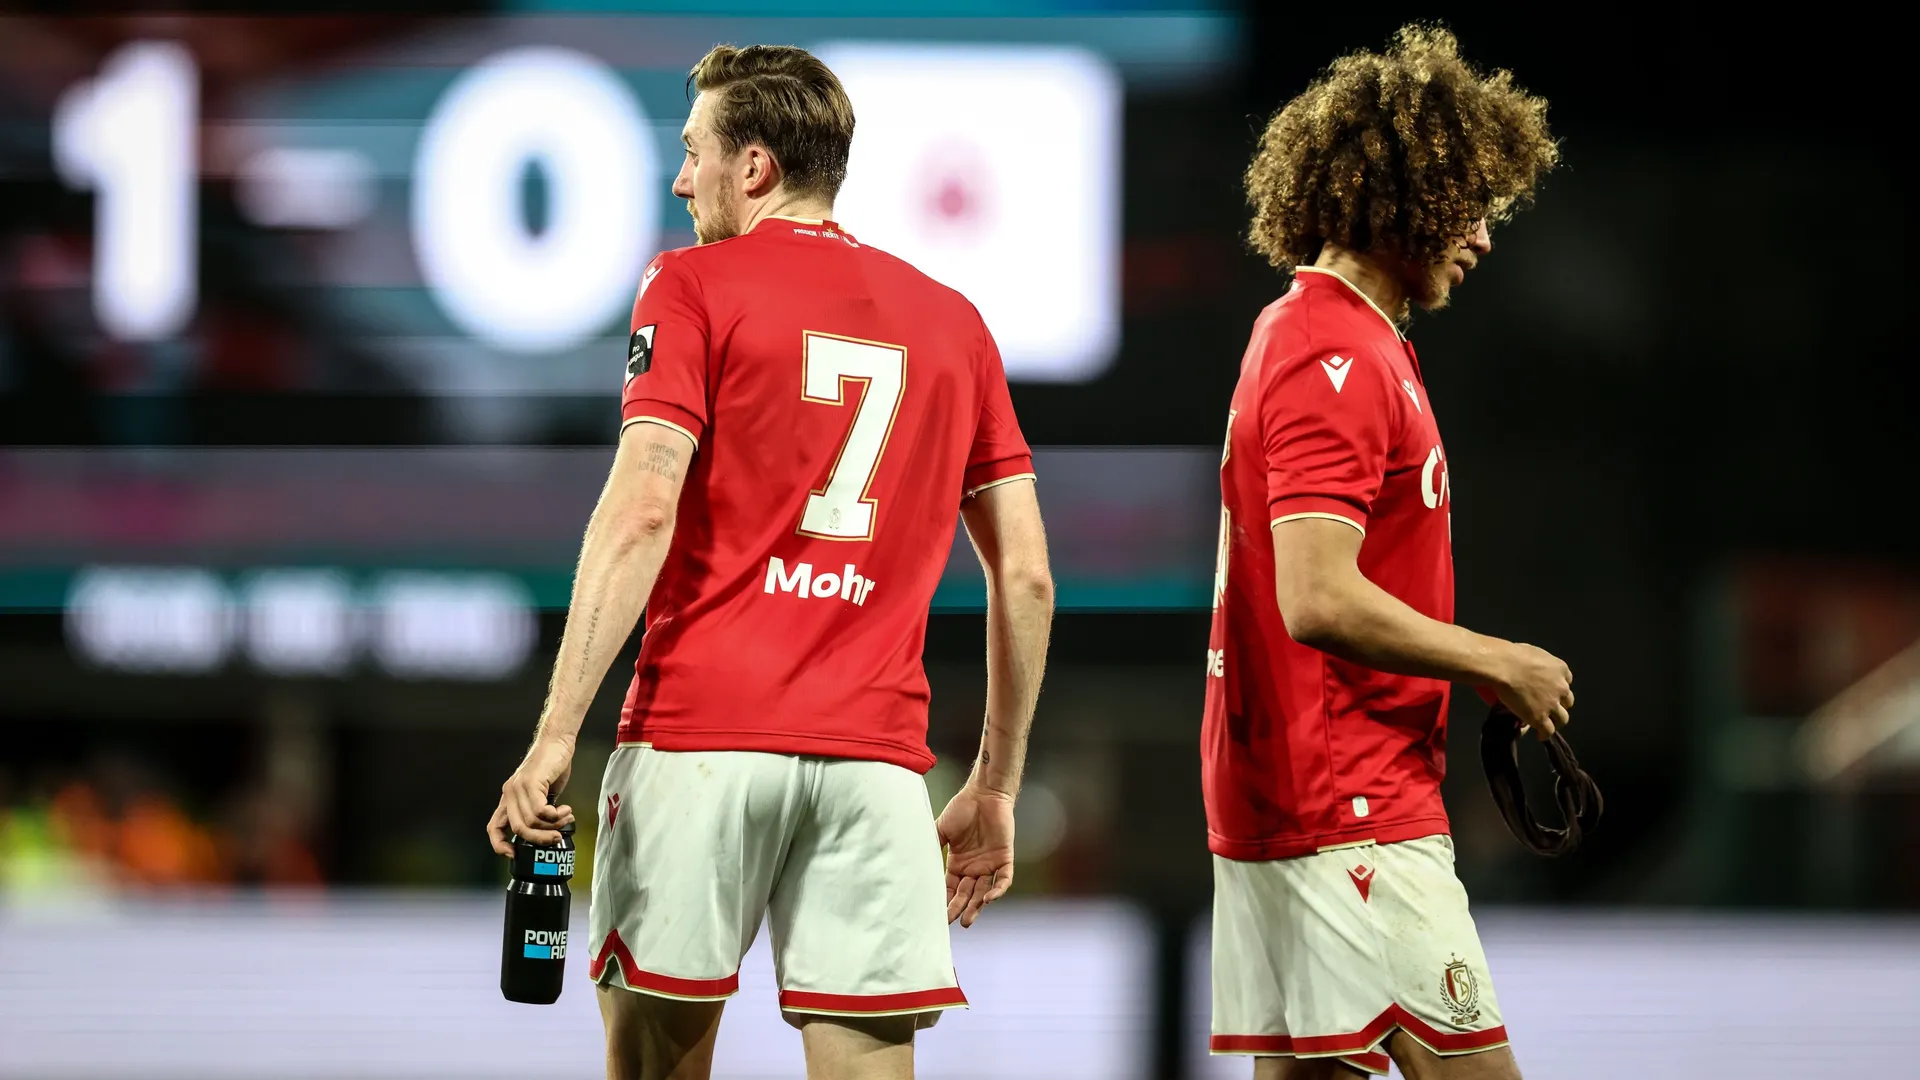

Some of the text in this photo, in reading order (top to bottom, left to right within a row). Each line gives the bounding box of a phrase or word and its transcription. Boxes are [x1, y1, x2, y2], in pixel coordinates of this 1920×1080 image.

[52, 40, 198, 342] 1
[411, 46, 660, 354] 0
[796, 330, 907, 542] 7
[764, 556, 876, 607] Mohr
[534, 849, 575, 863] POWE
[524, 929, 568, 945] POWE
[550, 945, 566, 960] AD
